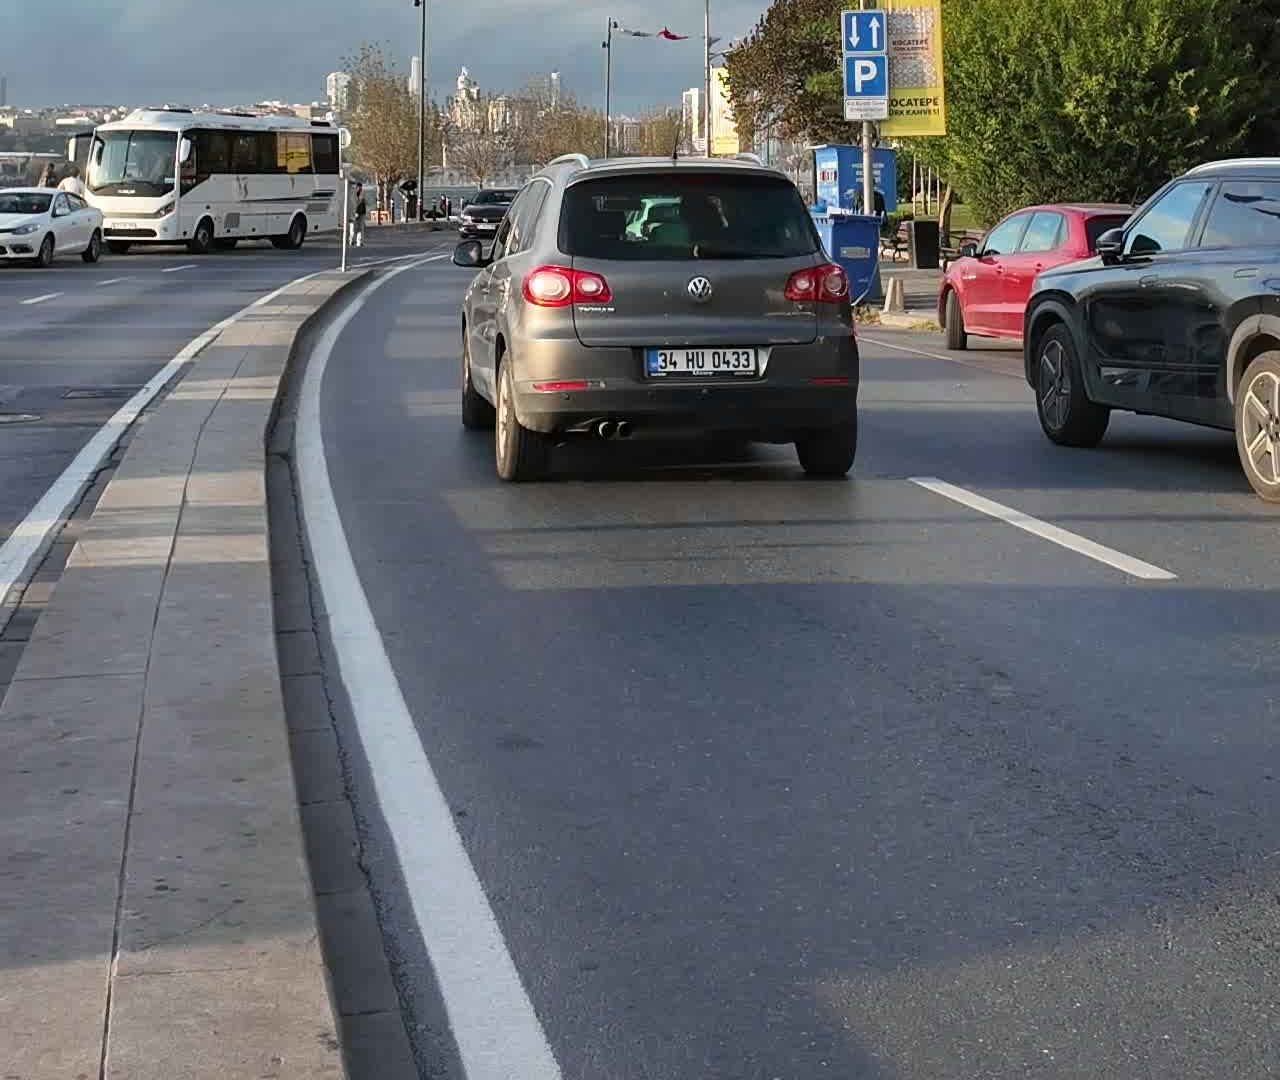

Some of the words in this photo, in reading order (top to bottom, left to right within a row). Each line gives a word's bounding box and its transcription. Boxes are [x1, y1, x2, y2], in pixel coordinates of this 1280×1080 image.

[855, 60, 877, 92] P
[889, 98, 939, 107] OCATEPE
[888, 108, 905, 116] ÜRK
[659, 353, 677, 369] 34
[686, 352, 705, 369] HU
[712, 351, 750, 369] 0433
